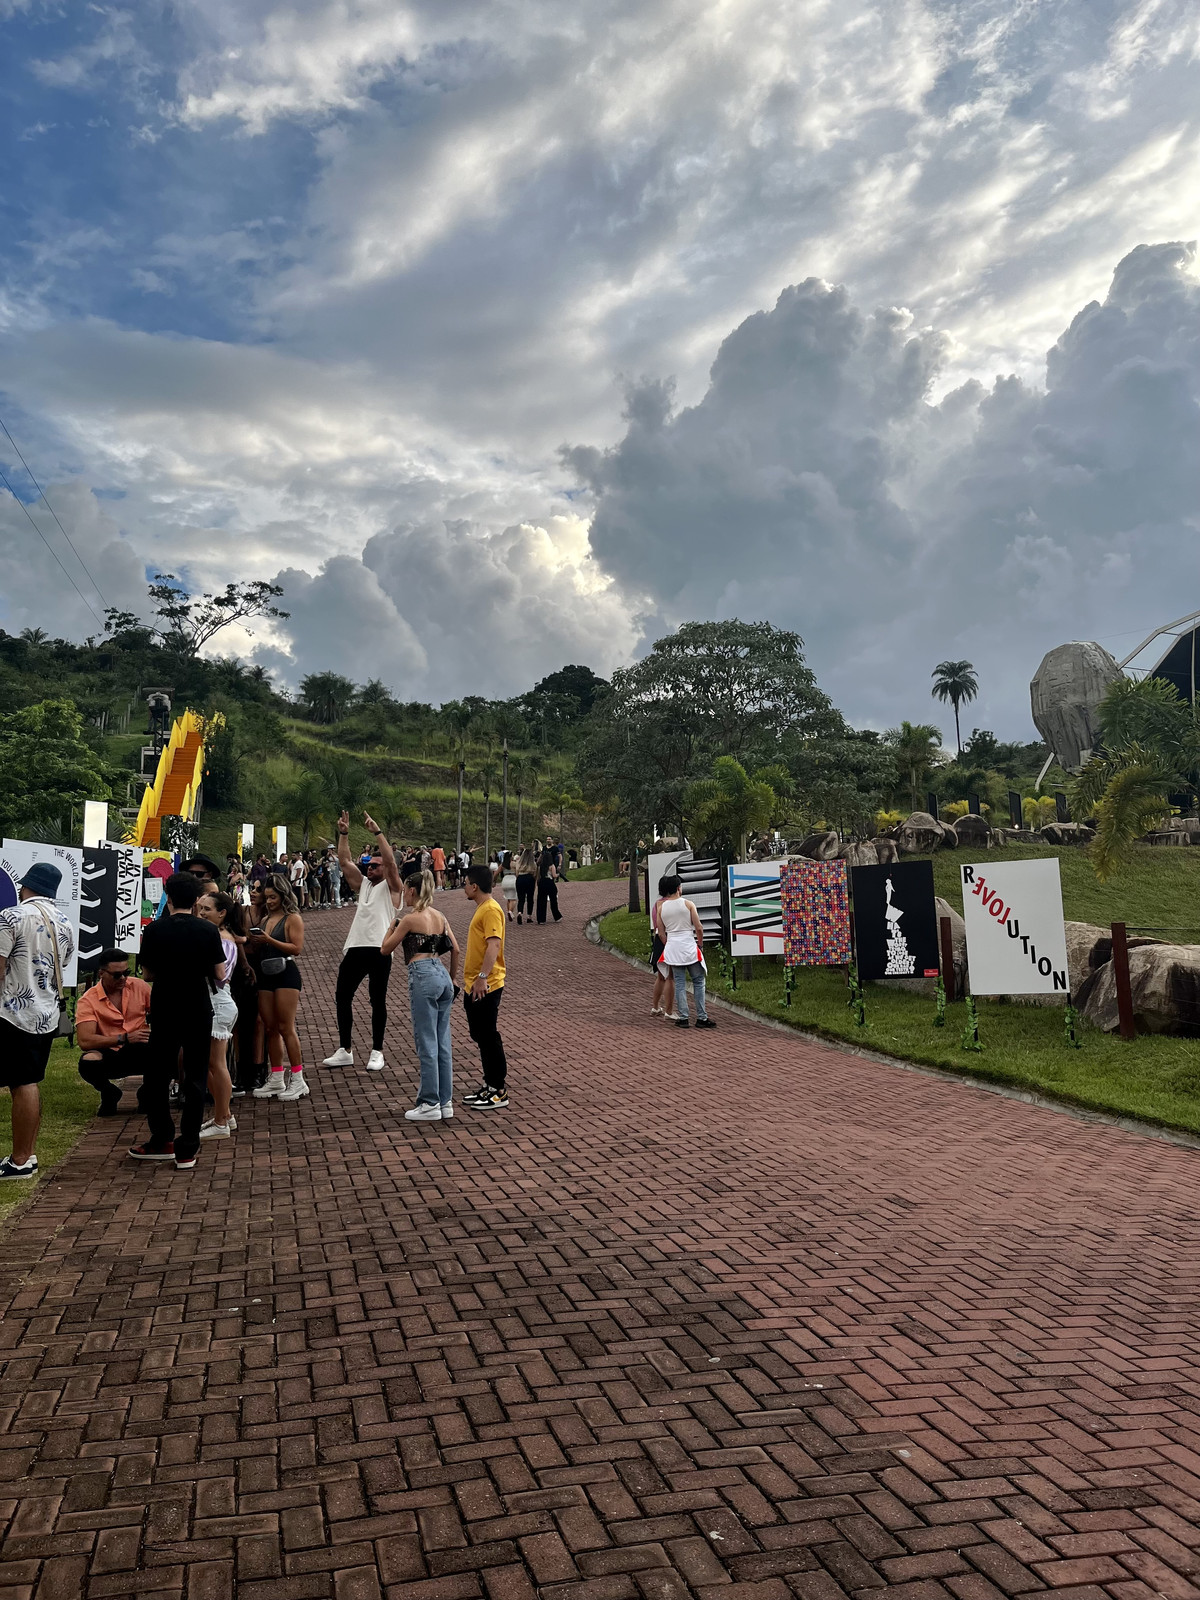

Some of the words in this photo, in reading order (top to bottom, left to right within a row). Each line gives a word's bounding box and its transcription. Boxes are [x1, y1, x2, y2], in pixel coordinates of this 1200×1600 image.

[54, 848, 65, 858] THE
[1, 858, 13, 872] YOU
[65, 853, 79, 877] WORLD
[72, 878, 79, 886] IN
[71, 888, 79, 901] YOU
